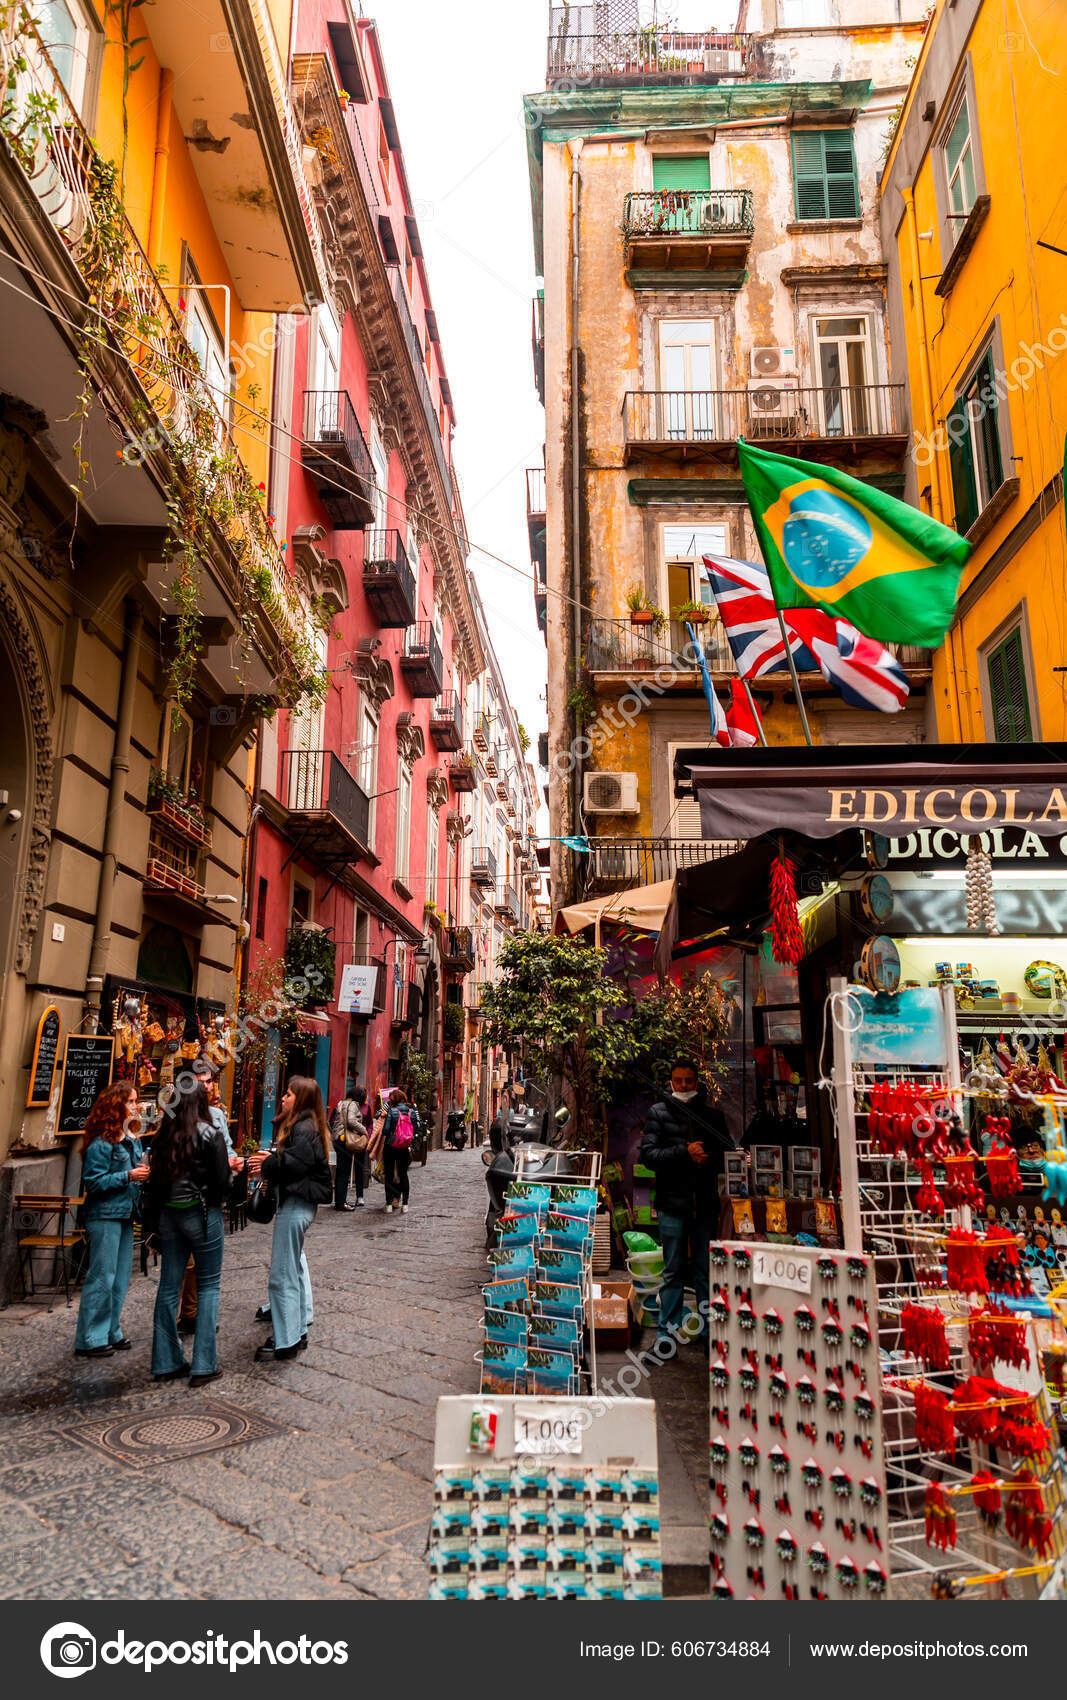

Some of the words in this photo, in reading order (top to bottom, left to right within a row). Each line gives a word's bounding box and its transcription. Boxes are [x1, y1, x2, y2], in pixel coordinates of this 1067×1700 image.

[825, 788, 1067, 823] EDICOLA
[860, 828, 1049, 858] DICOLA
[67, 1069, 99, 1077] TAGLIERE
[81, 1086, 96, 1095] DUE
[511, 1184, 547, 1197] NAPLES
[558, 1187, 594, 1199] NAPLES
[493, 1249, 530, 1261] NAPLES
[542, 1252, 578, 1264] NAPLES
